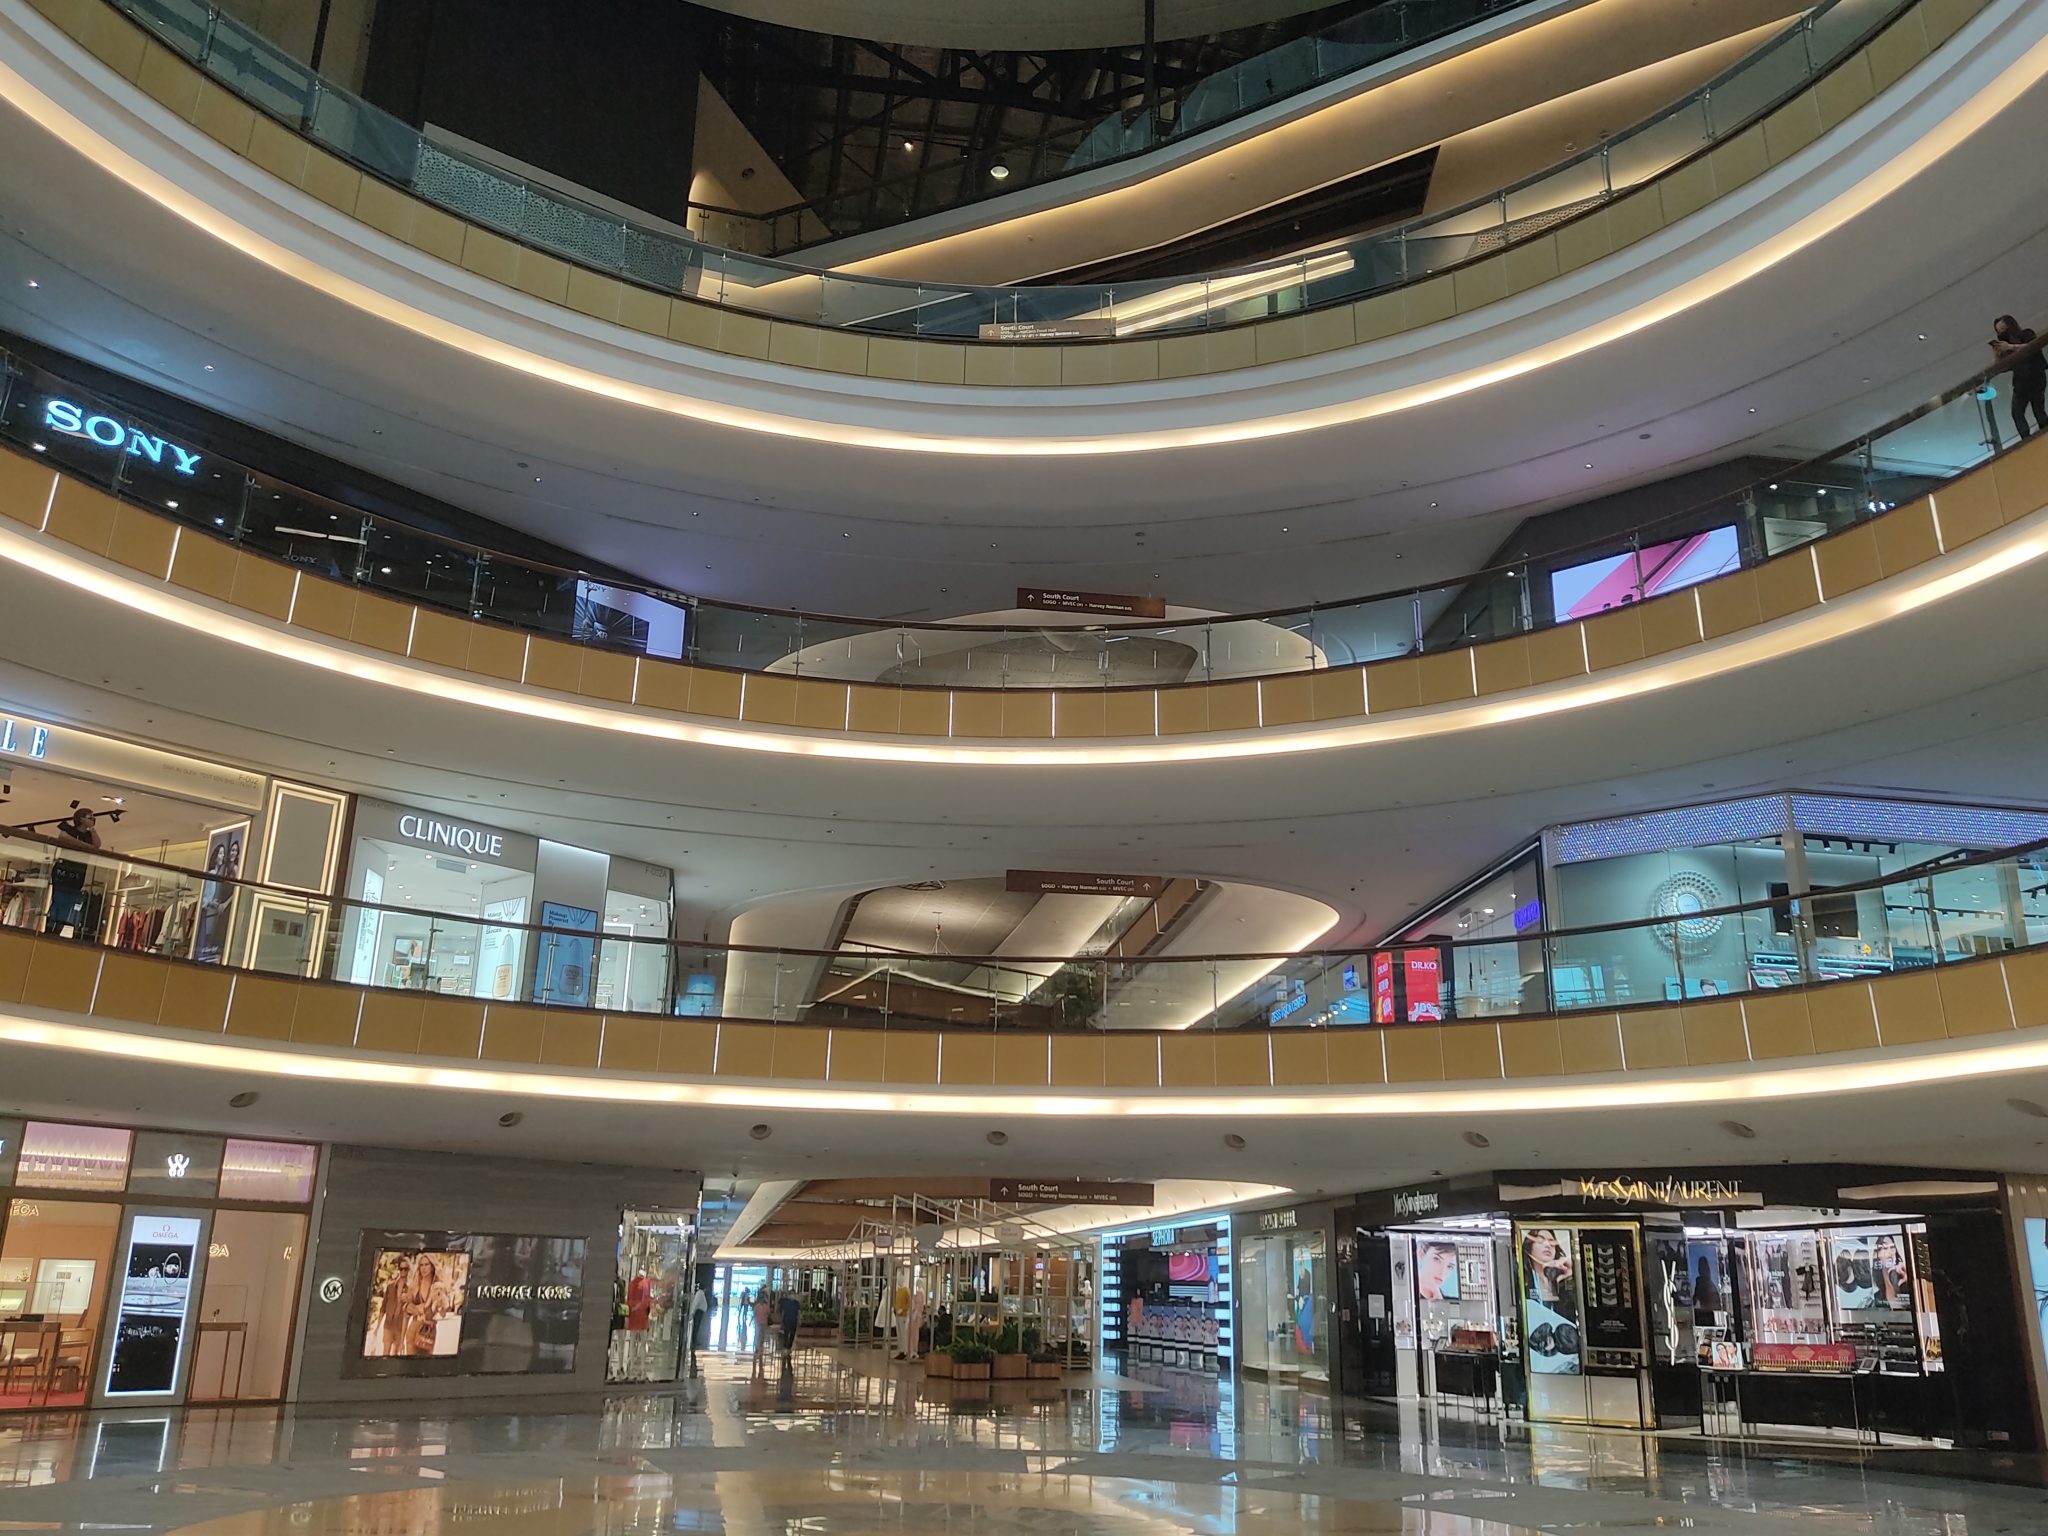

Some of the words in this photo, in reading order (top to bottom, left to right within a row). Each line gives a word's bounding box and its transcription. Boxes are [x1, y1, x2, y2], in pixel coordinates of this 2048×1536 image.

[46, 400, 201, 476] SONY
[1042, 592, 1061, 600] South
[399, 815, 503, 857] CLINIQUE
[1018, 1183, 1038, 1191] South
[1039, 1184, 1059, 1192] Court
[10, 1204, 40, 1217] EGA
[152, 1231, 178, 1239] OMEGA
[1152, 1228, 1174, 1247] SEPHORA
[477, 1285, 533, 1300] MICHAEL
[537, 1285, 572, 1299] KORS
